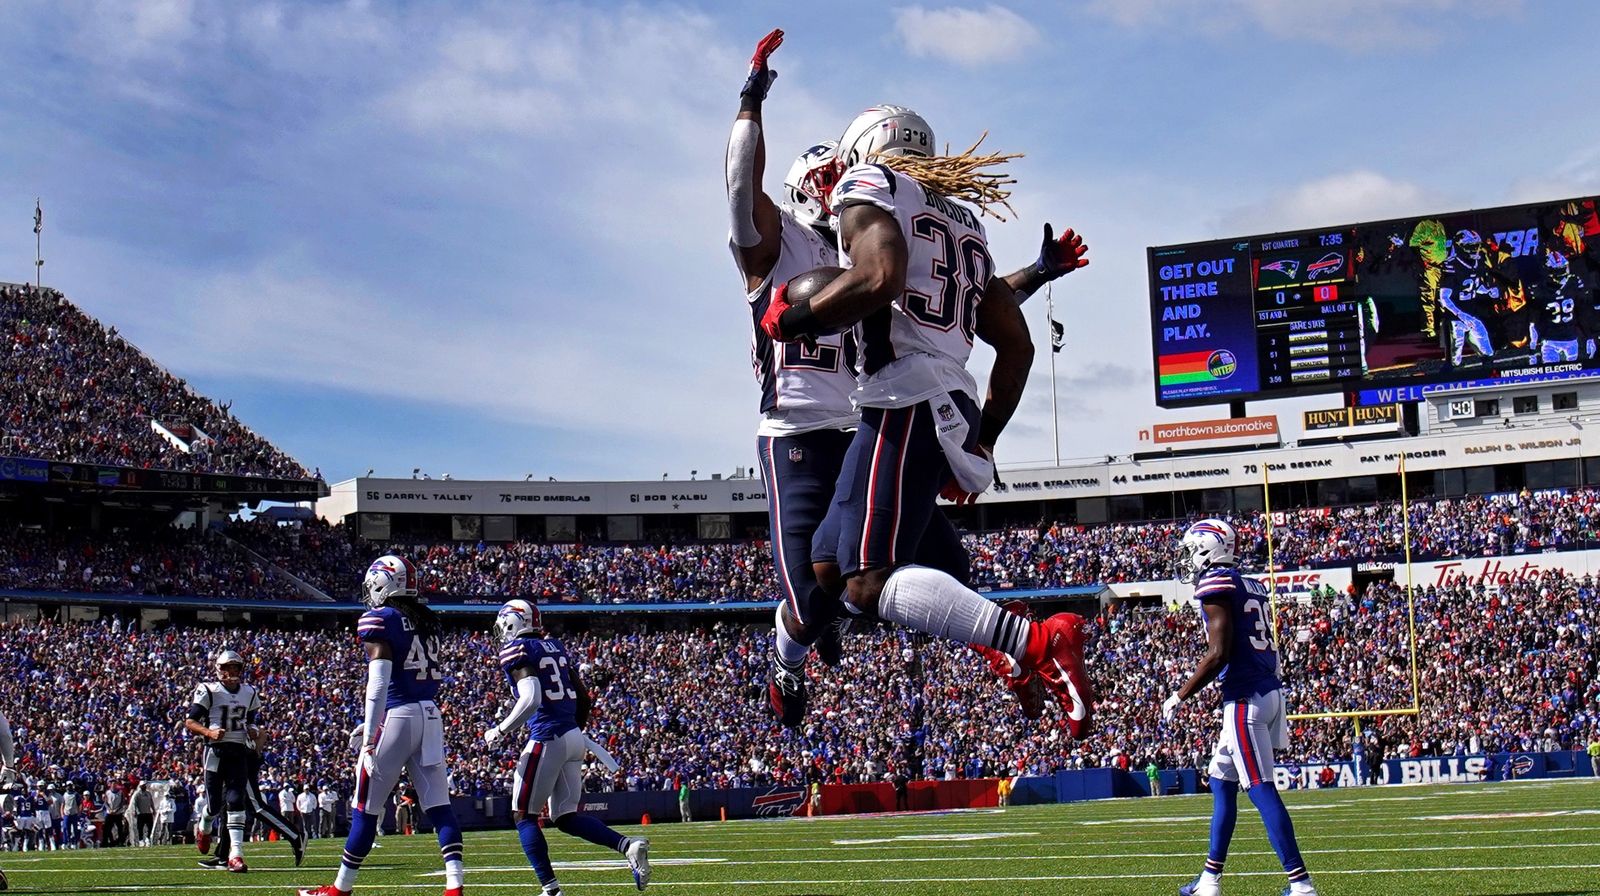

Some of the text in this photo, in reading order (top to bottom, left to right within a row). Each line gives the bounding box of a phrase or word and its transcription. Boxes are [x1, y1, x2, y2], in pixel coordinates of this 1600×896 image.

[1273, 238, 1299, 249] QUARTER
[1319, 233, 1343, 246] 7:35
[1159, 258, 1235, 280] GET OUT
[903, 212, 990, 344] 38
[1160, 281, 1218, 301] THERE
[1275, 291, 1286, 305] 0
[1320, 286, 1331, 300] 0
[1162, 304, 1201, 321] AND
[1163, 323, 1211, 341] PLAY.
[1500, 363, 1582, 378] MITSUBISHI ELECTRIC
[1355, 406, 1394, 420] HUNT
[1452, 400, 1471, 415] 40
[1308, 410, 1347, 424] HUNT
[1158, 420, 1272, 439] northtown automotive
[1464, 445, 1502, 454] RALPH
[1518, 439, 1563, 450] WILSON
[1360, 455, 1380, 463] PAT
[1243, 464, 1258, 475] 70
[1290, 459, 1332, 469] SESTAK
[1013, 481, 1039, 489] MIKE
[1044, 478, 1099, 488] STRATTON
[1112, 468, 1230, 484] 44 ELBERT DUBENION
[366, 491, 379, 500] 56
[433, 493, 473, 501] TALLEY
[499, 494, 512, 503] 76
[630, 494, 640, 503] 61
[731, 492, 744, 501] 68
[1434, 559, 1565, 588] Tim Hortos
[219, 705, 248, 731] 12
[1400, 757, 1487, 785] BILLS
